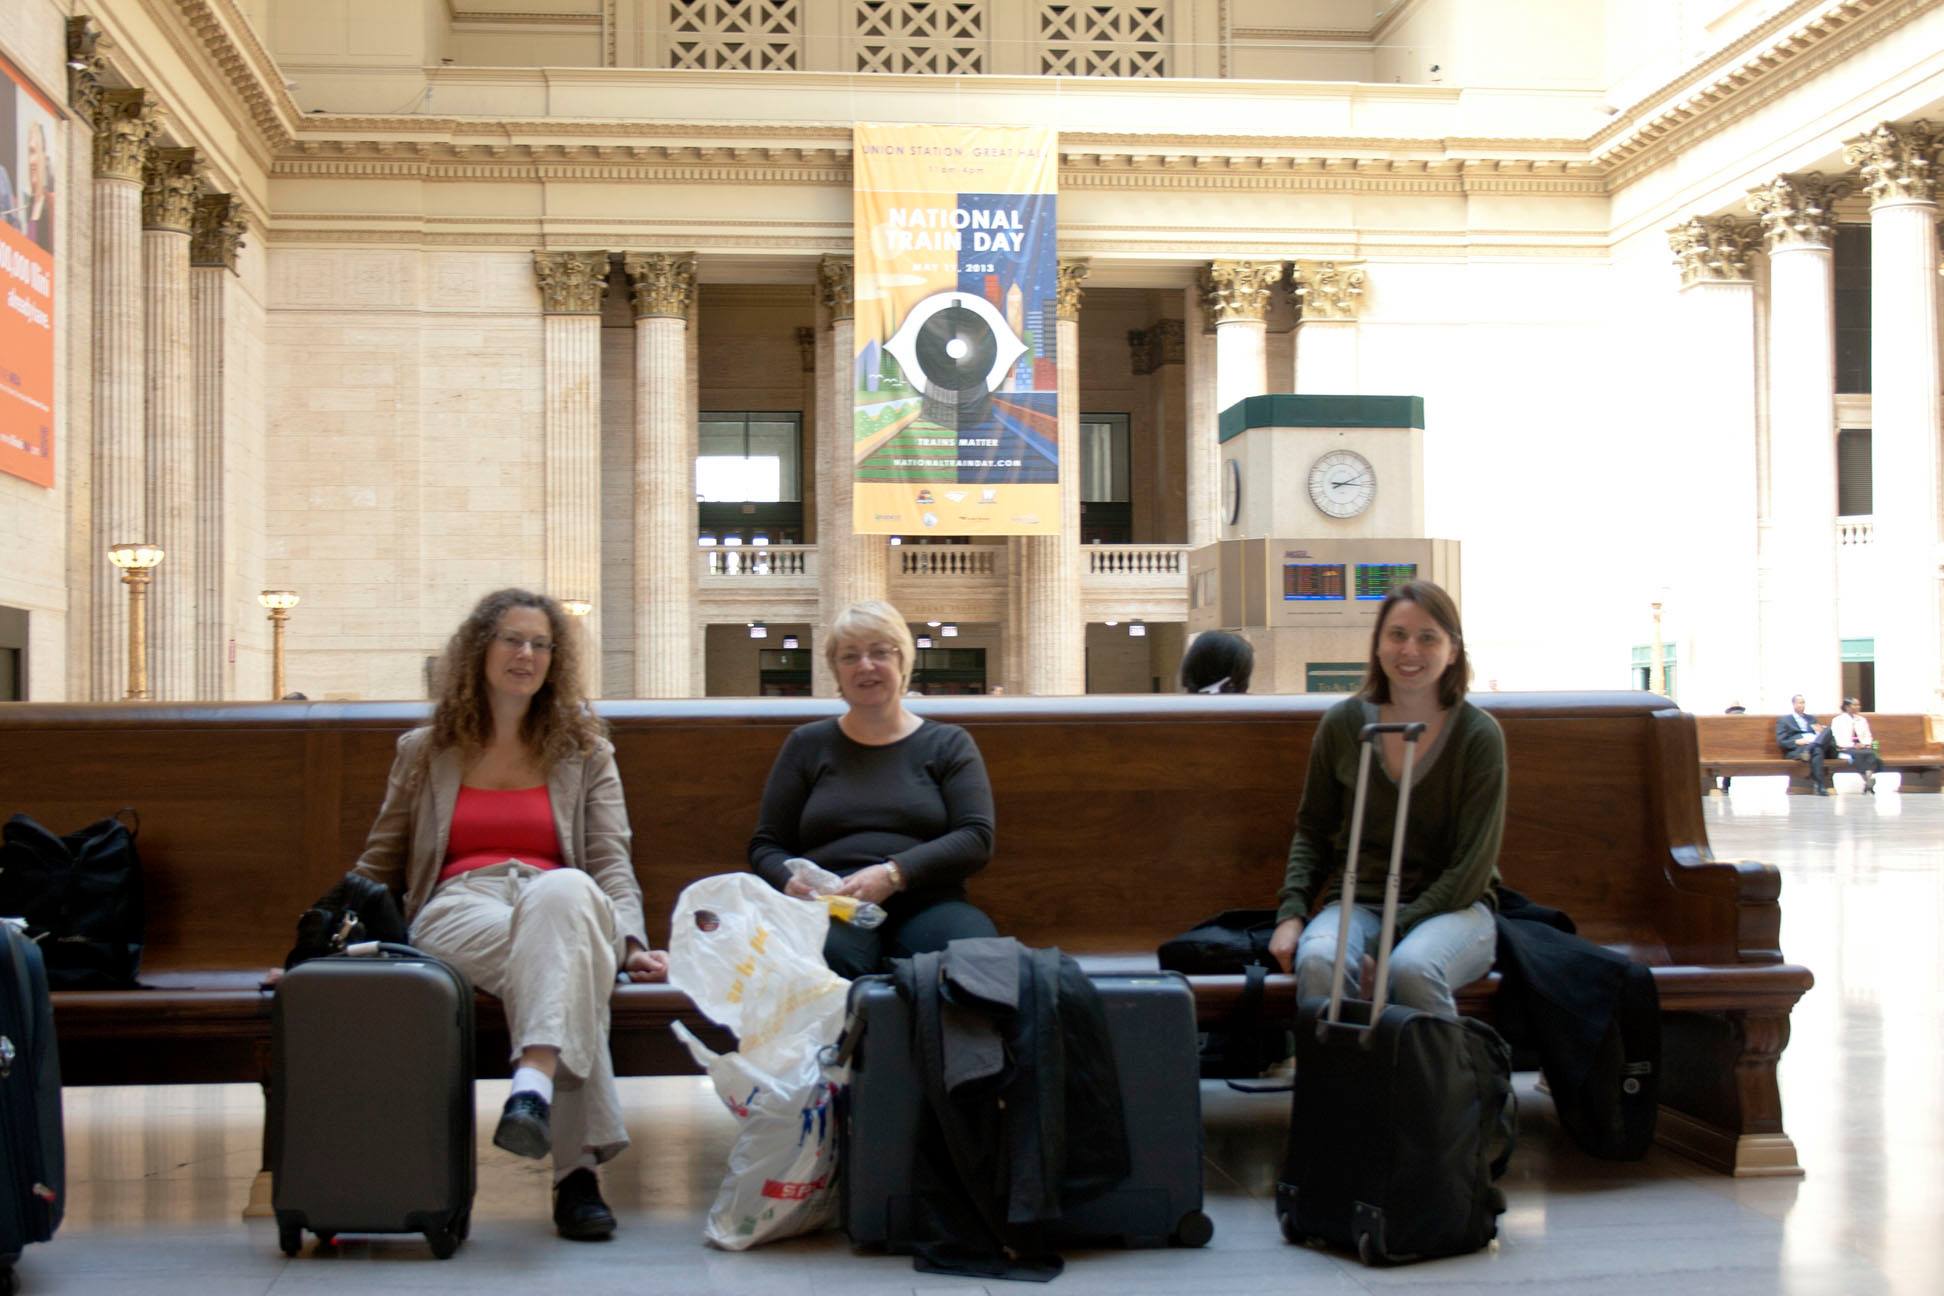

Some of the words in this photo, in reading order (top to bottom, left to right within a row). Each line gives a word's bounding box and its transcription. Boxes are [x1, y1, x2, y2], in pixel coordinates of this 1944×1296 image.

[862, 145, 905, 156] UNION
[910, 146, 963, 157] STATION
[973, 147, 1013, 158] GREAT
[889, 208, 1024, 229] NATIONAL
[886, 230, 962, 251] TRAIN
[973, 231, 1026, 252] DAY
[964, 263, 995, 273] 2013
[917, 438, 956, 447] TRAINS
[958, 438, 999, 447] MATTER
[893, 458, 1022, 468] NATIONALTRAINDAY.COM
